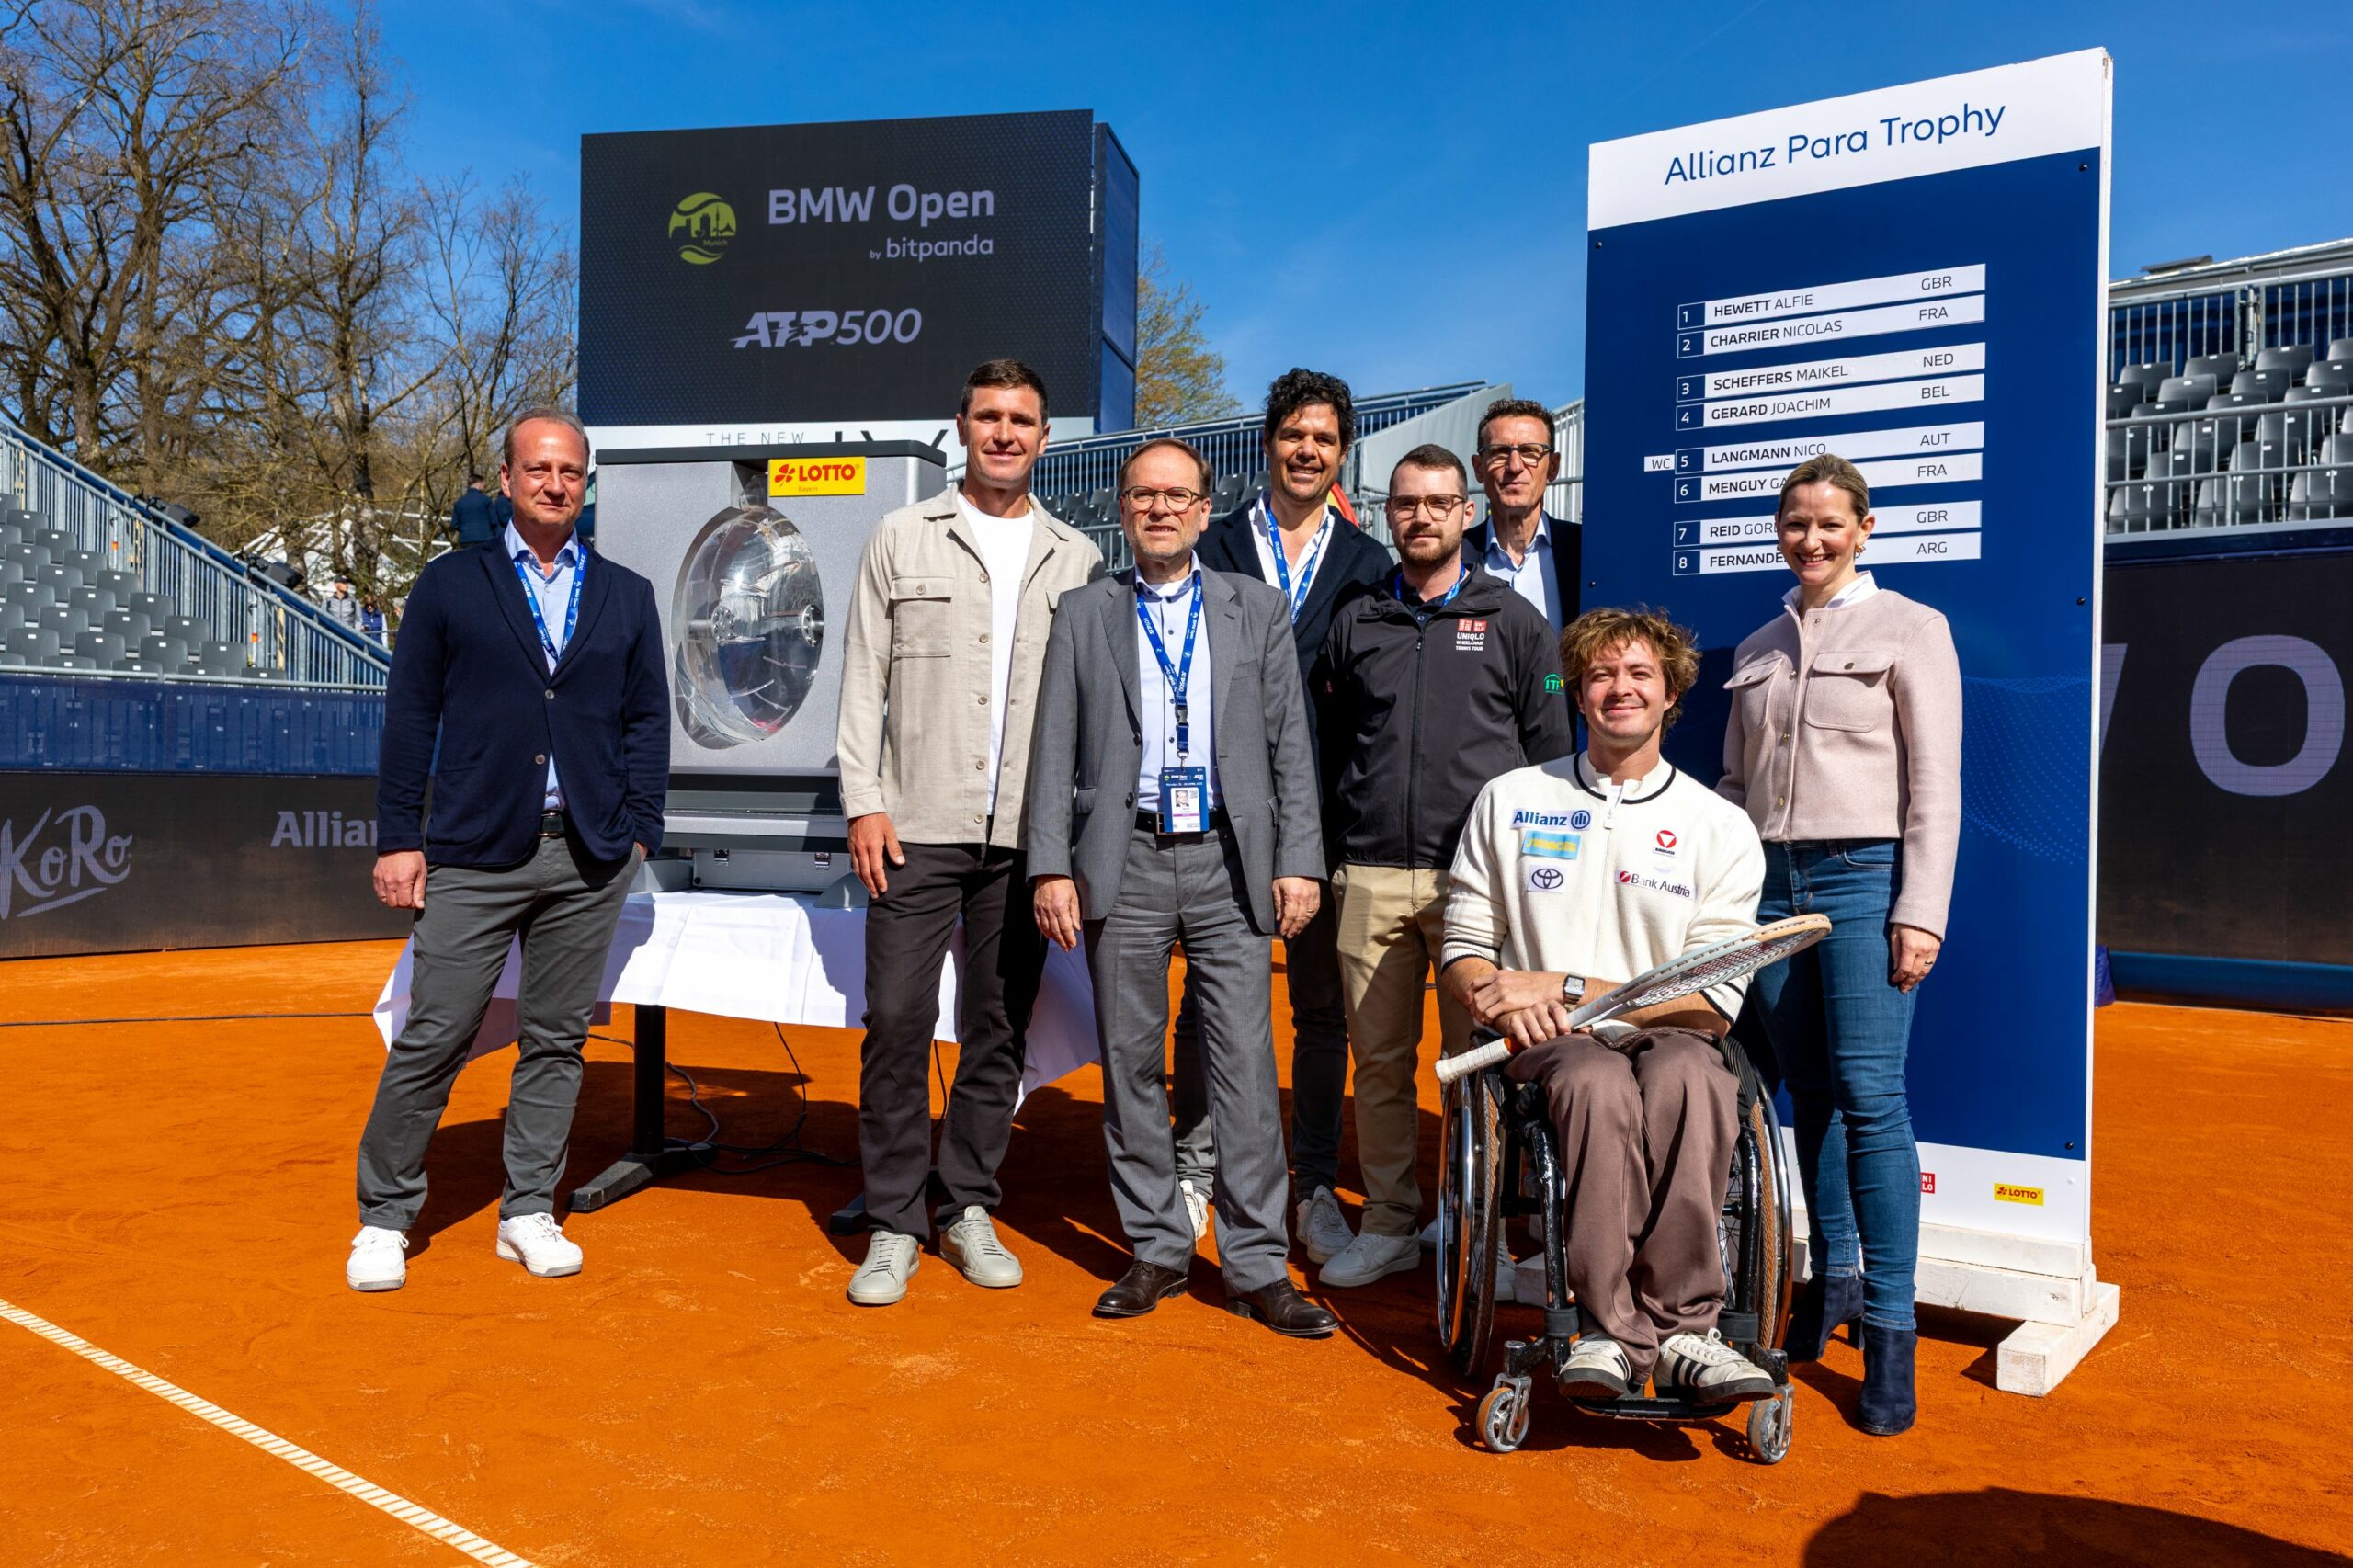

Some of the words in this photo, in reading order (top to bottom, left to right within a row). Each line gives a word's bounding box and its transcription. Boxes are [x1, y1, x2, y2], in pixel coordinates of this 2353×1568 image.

[1664, 146, 1776, 186] Allianz
[1788, 130, 1868, 164] Para
[1879, 103, 2006, 147] Trophy
[768, 186, 876, 225] BMW
[888, 183, 995, 228] Open
[870, 249, 881, 261] by
[886, 234, 994, 263] bitpanda
[1683, 311, 1688, 323] 1
[1714, 300, 1772, 317] HEWETT
[1774, 294, 1813, 310] ALFIE
[1921, 275, 1952, 290] GBR
[730, 308, 922, 348] ATP500
[1682, 338, 1691, 352] 2
[1711, 328, 1779, 347] CHARRIER
[1783, 320, 1843, 338] NICOLAS
[1918, 306, 1949, 322] FRA
[1681, 382, 1690, 395] 3
[1713, 370, 1793, 391] SCHEFFERS
[1796, 365, 1848, 381] MAIKEL
[1923, 353, 1954, 368] NED
[1680, 411, 1689, 424] 4
[1711, 403, 1768, 420] GERARD
[1770, 397, 1831, 415] JOACHIM
[1921, 385, 1950, 400] BEL
[706, 432, 746, 446] THE
[760, 431, 805, 446] NEW
[1652, 458, 1670, 470] WC
[1680, 455, 1688, 468] 5
[1711, 446, 1790, 464] LANGMANN
[1794, 443, 1826, 457] NICO
[1919, 432, 1951, 447] AUT
[798, 463, 857, 482] LOTTO
[1679, 483, 1688, 496] 6
[1709, 478, 1768, 494] MENGUY
[1917, 463, 1948, 478] FRA
[798, 485, 818, 494] Bayern
[1678, 528, 1688, 540] 7
[1710, 524, 1741, 538] REID
[1916, 509, 1948, 524] GBR
[1678, 556, 1688, 569] 8
[1710, 552, 1786, 568] FERNANDE
[1916, 541, 1948, 555] ARG
[1456, 632, 1485, 641] UNIQLO
[1513, 811, 1568, 826] Allianz
[1631, 873, 1658, 890] Bank
[1659, 881, 1691, 898] Austria
[1922, 1175, 1932, 1183] NI
[1922, 1183, 1933, 1191] LO
[2008, 1188, 2038, 1199] LOTTO
